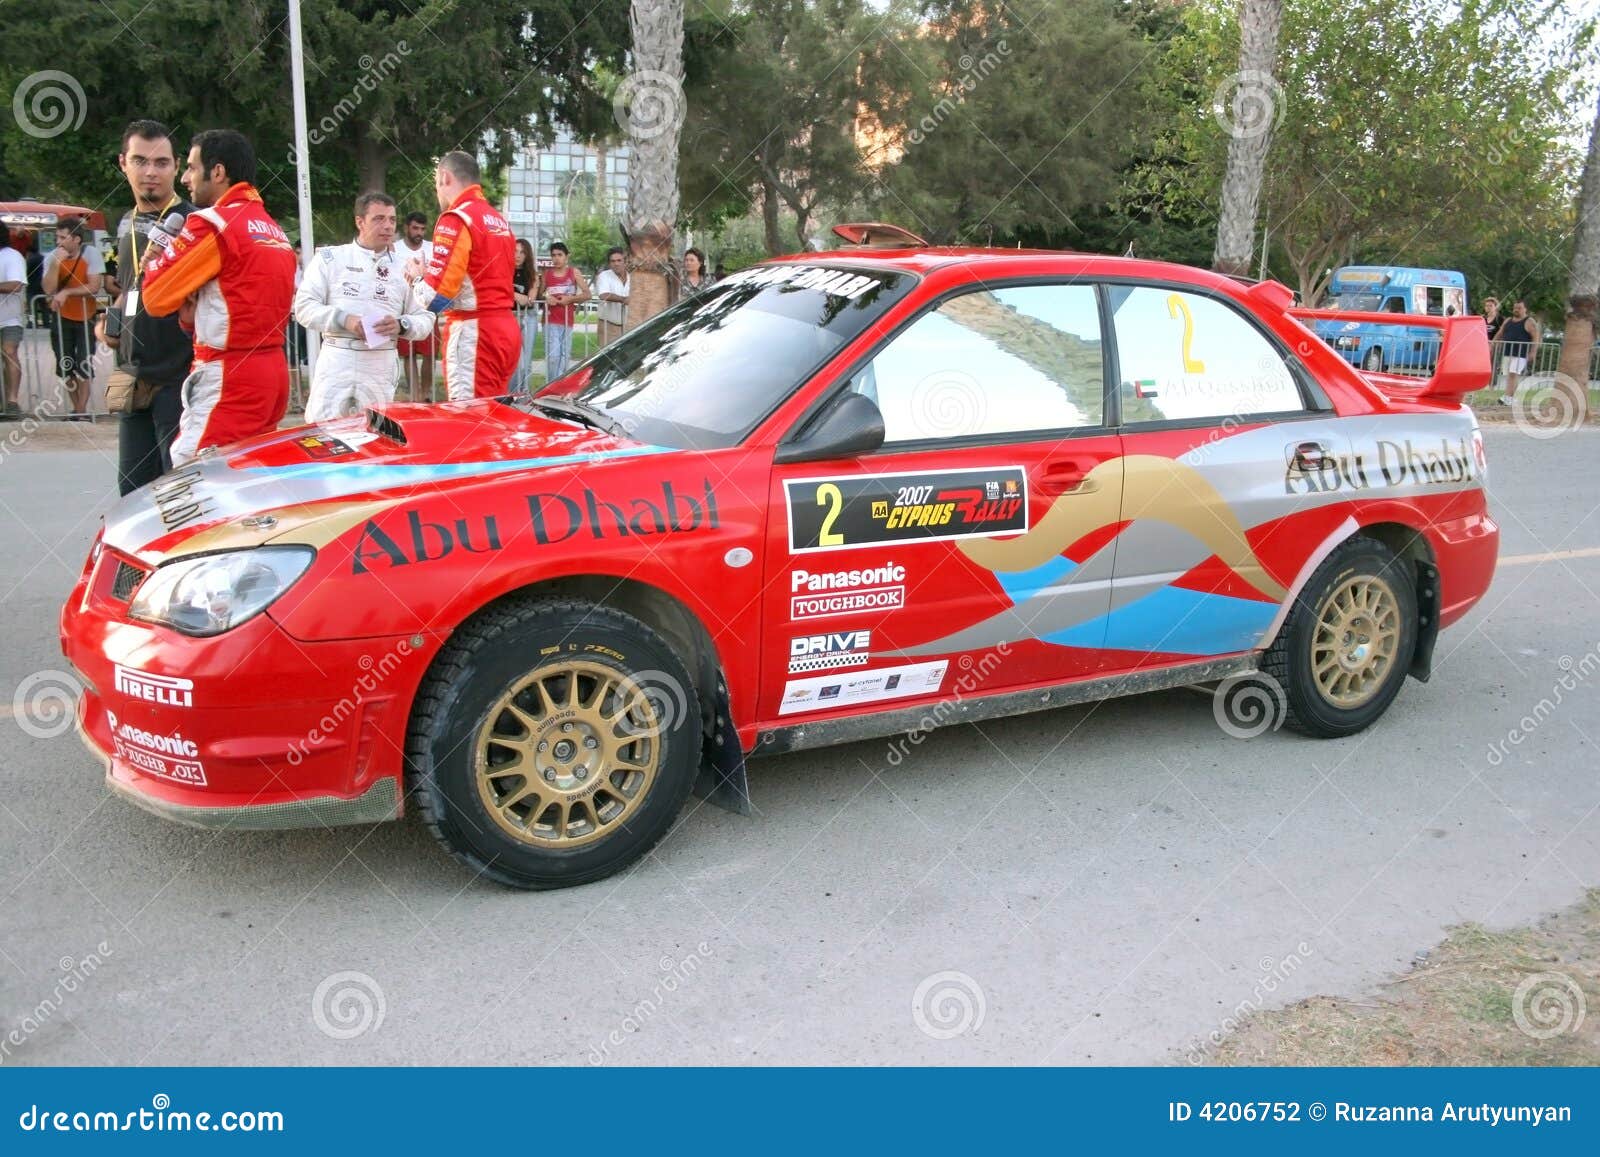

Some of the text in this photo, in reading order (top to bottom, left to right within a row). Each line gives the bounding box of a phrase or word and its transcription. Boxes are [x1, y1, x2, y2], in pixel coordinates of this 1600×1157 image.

[1167, 293, 1205, 374] 2
[1377, 438, 1472, 487] Dhabi
[816, 482, 844, 547] 2
[874, 505, 887, 517] AA
[886, 488, 1023, 529] CYPRUS RALLY
[894, 485, 934, 506] 2007
[352, 477, 721, 575] Abu Dhabi
[791, 561, 906, 593] Panasonic
[796, 591, 901, 615] TOUGHBOOK
[791, 630, 870, 656] DRIVE
[114, 663, 194, 708] PIRELLI
